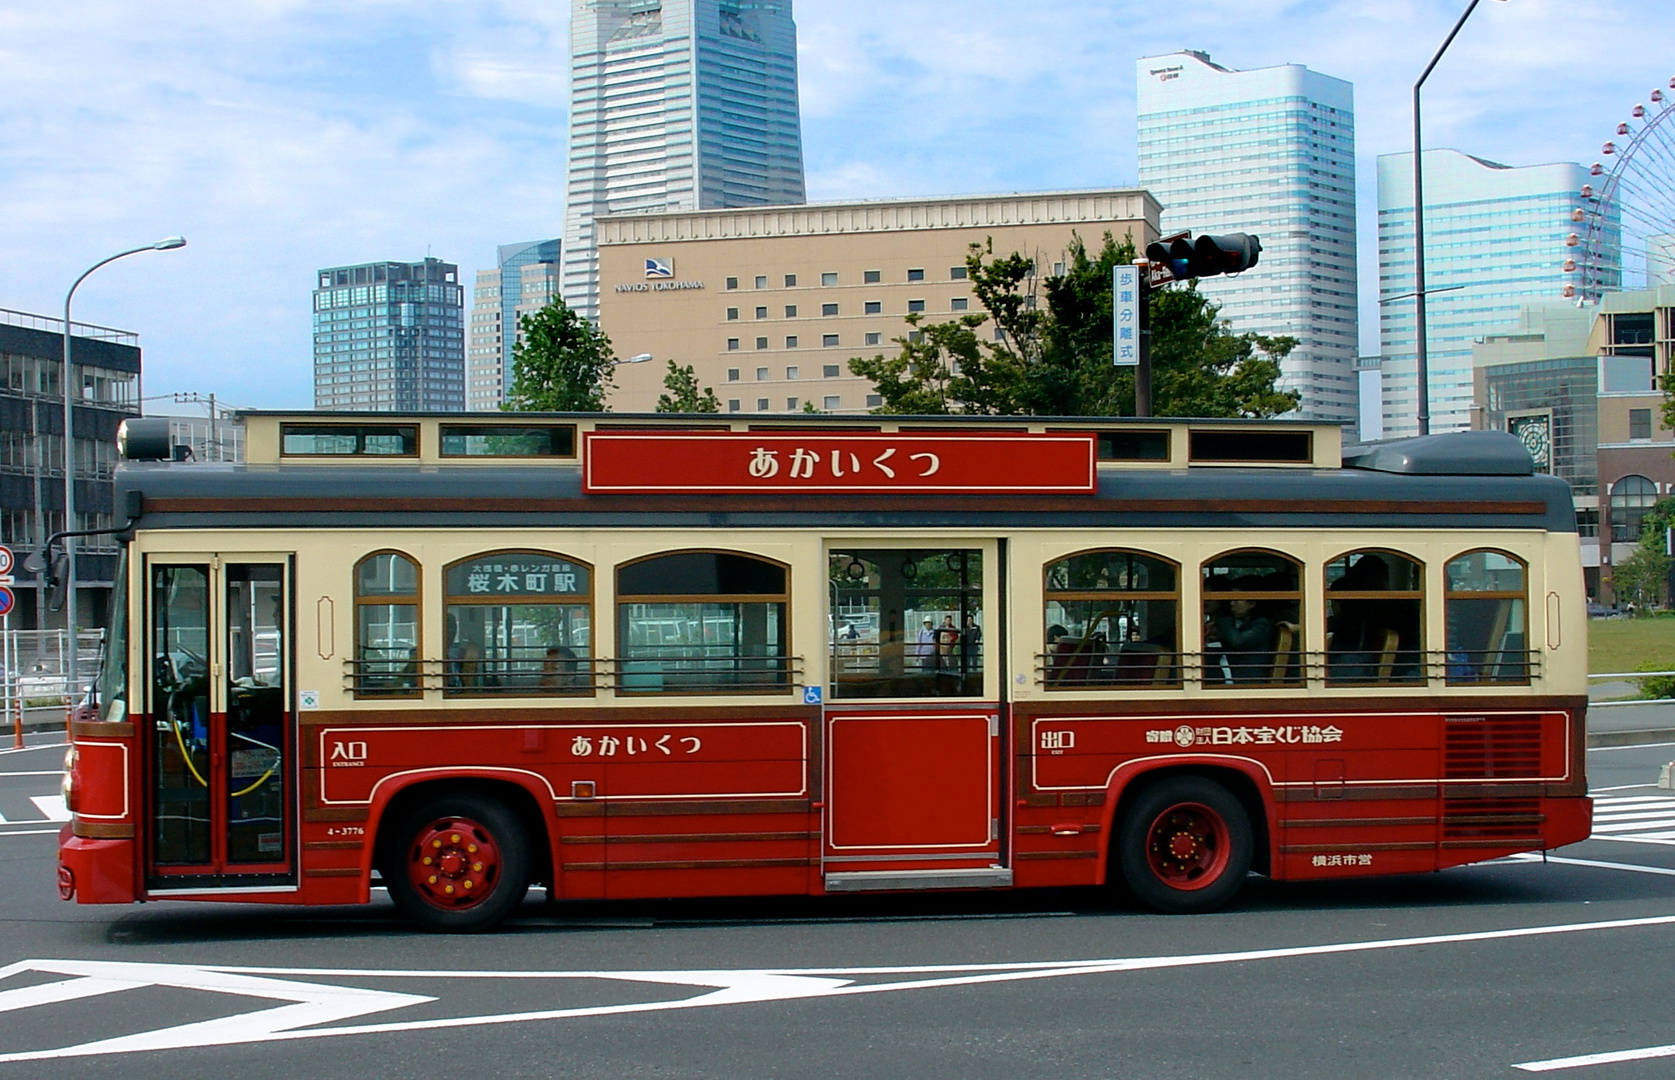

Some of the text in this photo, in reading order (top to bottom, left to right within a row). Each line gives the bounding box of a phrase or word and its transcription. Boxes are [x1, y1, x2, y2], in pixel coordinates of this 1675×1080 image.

[614, 280, 704, 293] NAVIOS YOKOHAMA
[1120, 272, 1133, 358] 歩車分離式
[748, 447, 940, 479] あかいくつ
[467, 573, 576, 592] 桜木町駅
[1041, 731, 1075, 749] 出口
[1212, 725, 1344, 745] 日本宝くじ協会
[330, 741, 367, 760] 入口
[571, 734, 701, 756] あかいくつ
[1311, 853, 1373, 867] 横浜市営
